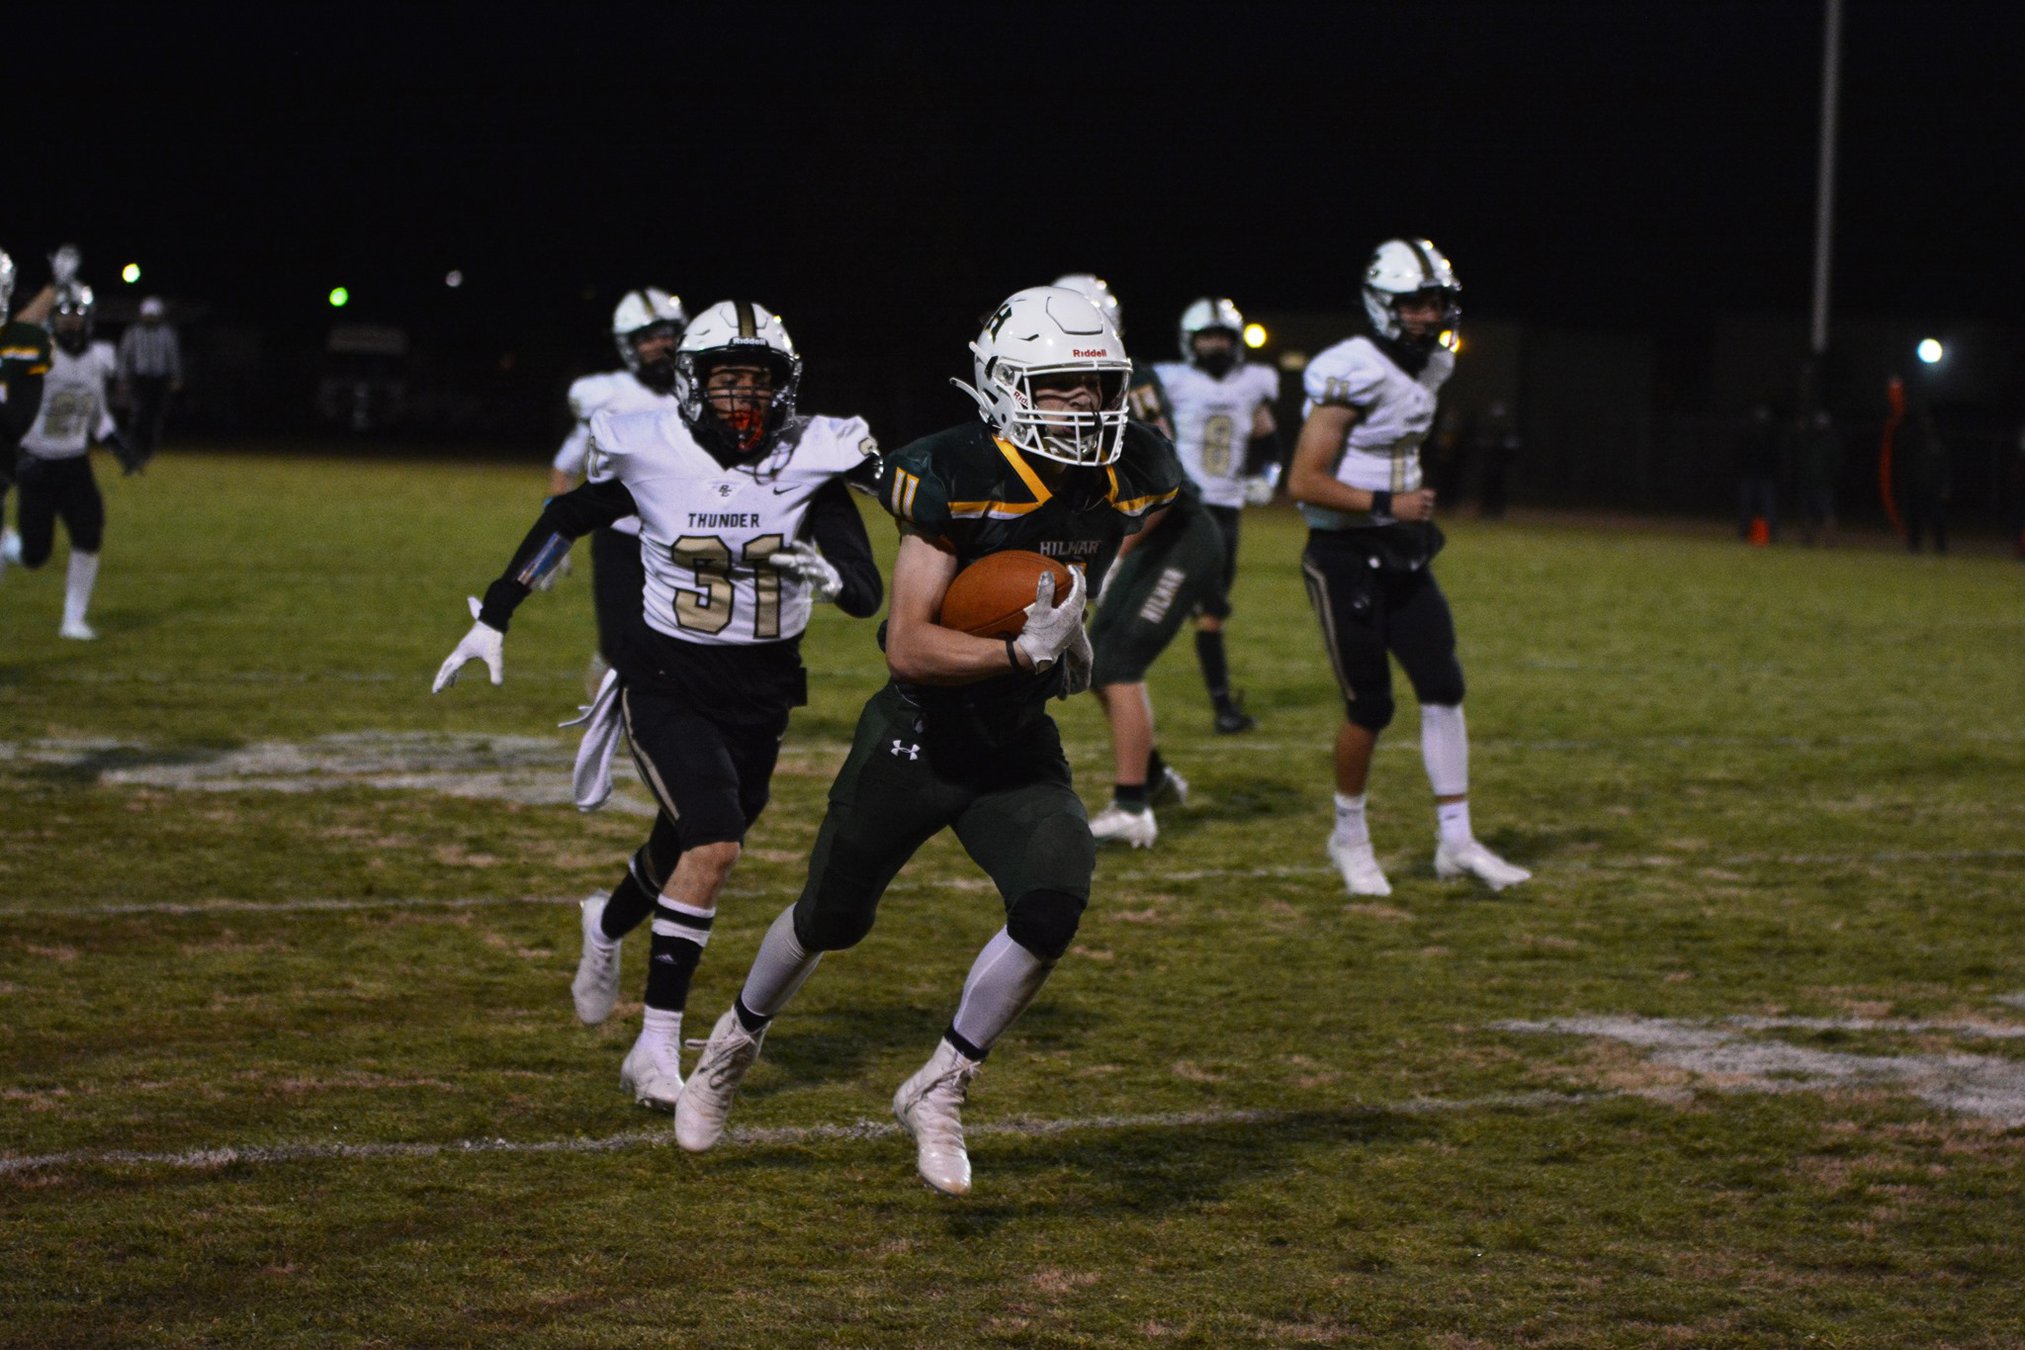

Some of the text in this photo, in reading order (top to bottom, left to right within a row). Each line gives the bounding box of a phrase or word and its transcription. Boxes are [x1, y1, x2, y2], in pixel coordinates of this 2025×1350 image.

[1073, 349, 1107, 357] Riddell
[688, 513, 760, 528] THUNDER
[1040, 541, 1099, 555] HILMAR
[671, 534, 784, 639] 31
